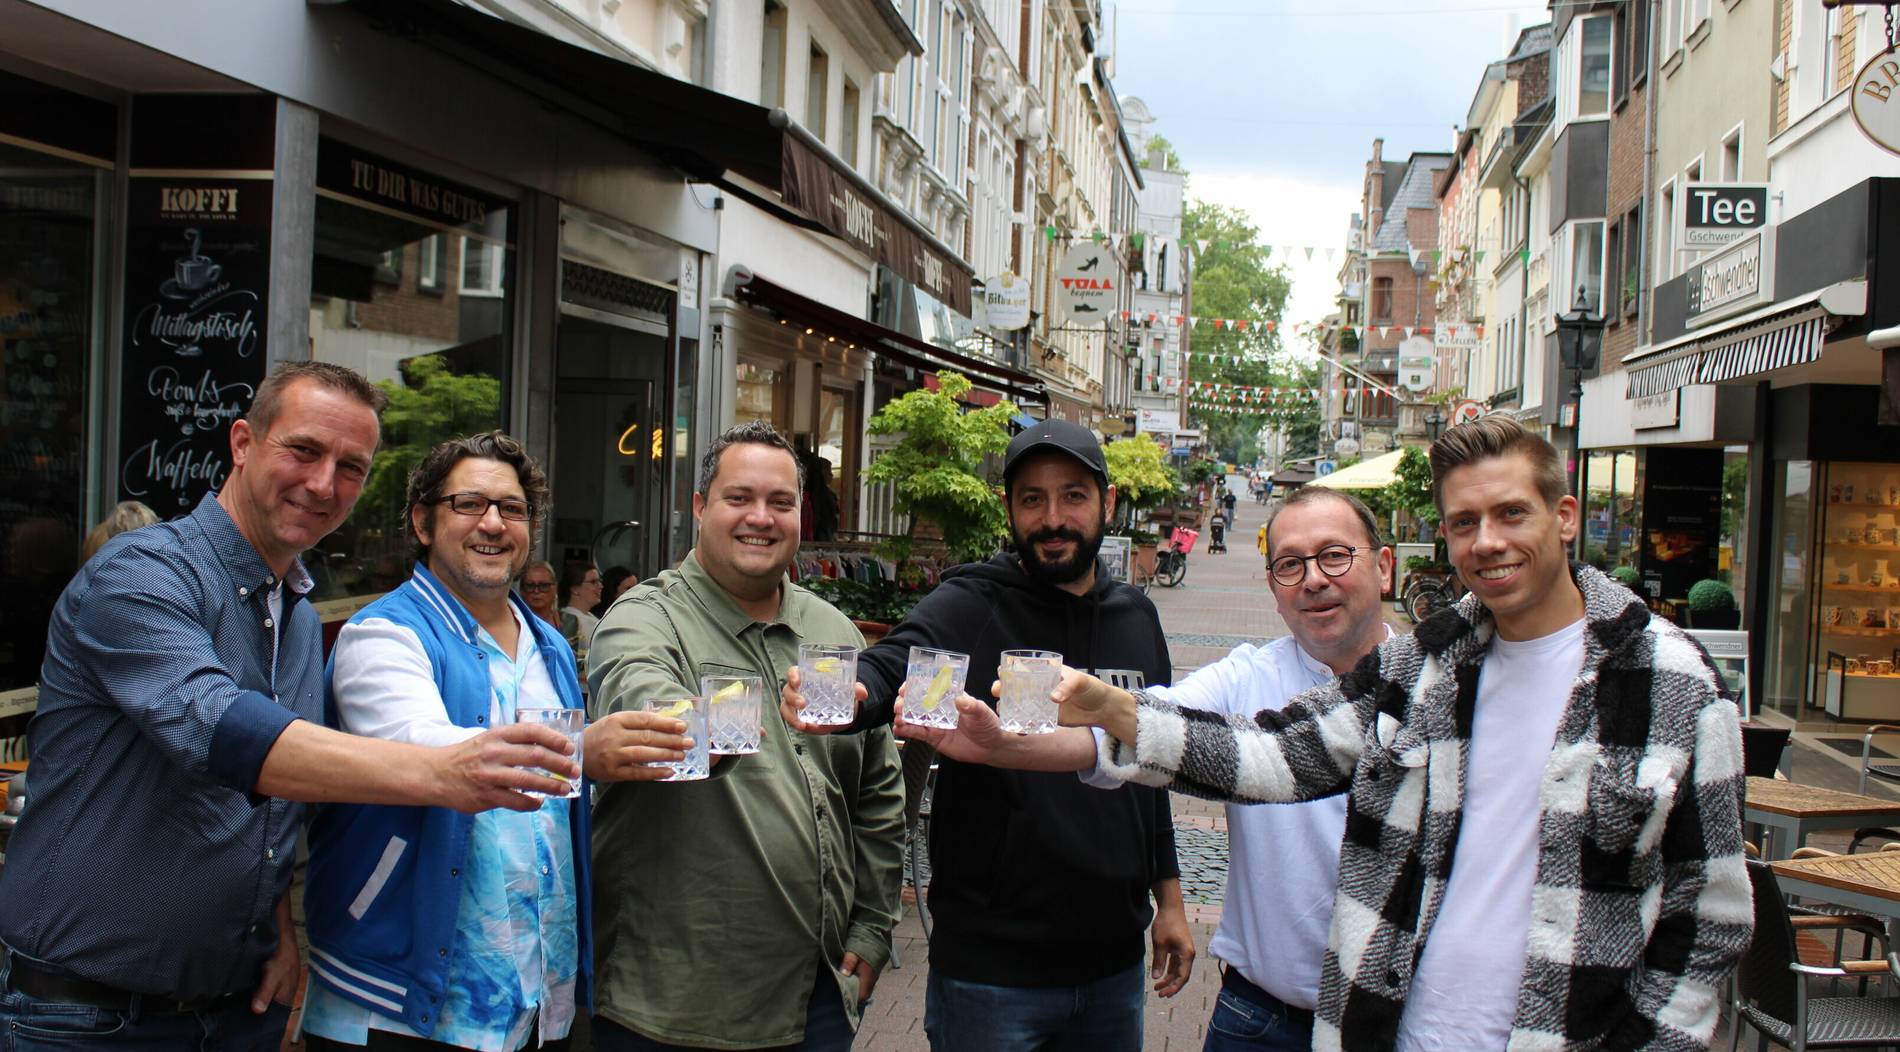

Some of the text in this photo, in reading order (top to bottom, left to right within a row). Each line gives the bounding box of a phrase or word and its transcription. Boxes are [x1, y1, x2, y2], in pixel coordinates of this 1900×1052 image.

[161, 187, 238, 213] KOFFI
[352, 159, 486, 226] TU DIR WAS GUTES
[1694, 190, 1756, 224] Tee
[845, 189, 874, 249] KOFFI
[133, 303, 257, 357] Mittagstisch
[148, 367, 240, 403] Bowls
[135, 440, 224, 492] Waffeln
